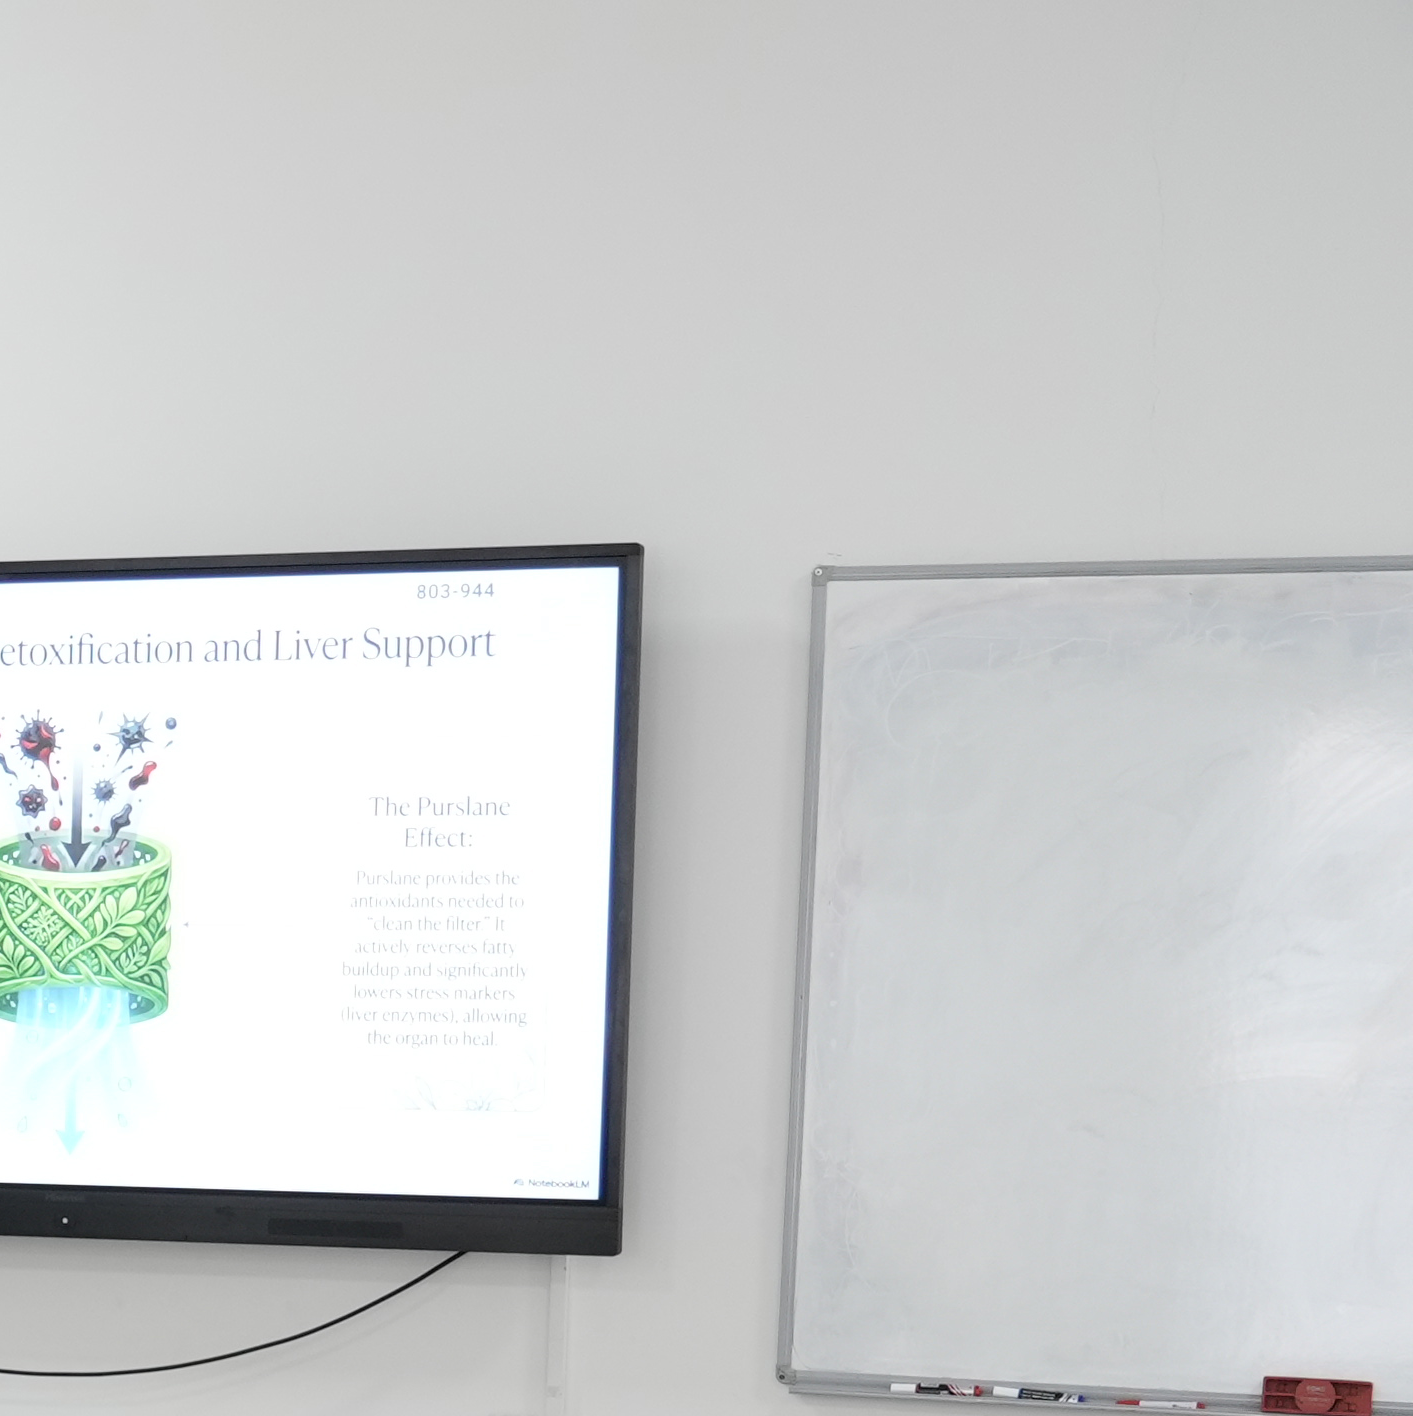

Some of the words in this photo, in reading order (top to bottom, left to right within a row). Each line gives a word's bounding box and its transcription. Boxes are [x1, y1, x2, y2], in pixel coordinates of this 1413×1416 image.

[417, 583, 495, 600] 803-944
[204, 629, 262, 663] and
[274, 629, 353, 661] Liver
[363, 627, 496, 667] Support
[369, 796, 410, 816] The
[418, 796, 510, 816] Purslane
[405, 827, 472, 847] Effect:
[356, 870, 421, 885] Purslane
[426, 870, 490, 889] provides
[495, 870, 520, 885] the
[350, 893, 443, 908] antioxidants
[448, 893, 504, 908] needed
[509, 896, 524, 908] to
[418, 917, 441, 931] the
[495, 917, 505, 931] It
[354, 940, 410, 957] actively
[416, 942, 478, 954] reverses
[483, 939, 515, 957] fatty
[342, 962, 399, 980] buildup
[404, 963, 431, 977] and
[437, 963, 527, 981] significantly
[354, 985, 401, 999] lowers
[407, 987, 449, 1000] stress
[455, 986, 515, 1000] markers
[341, 1006, 377, 1023] (liver
[382, 1008, 458, 1025] enzymes),
[463, 1008, 527, 1027] allowing
[368, 1030, 391, 1045] the
[396, 1033, 438, 1049] organ
[444, 1033, 459, 1045] to
[463, 1031, 497, 1046] heal.
